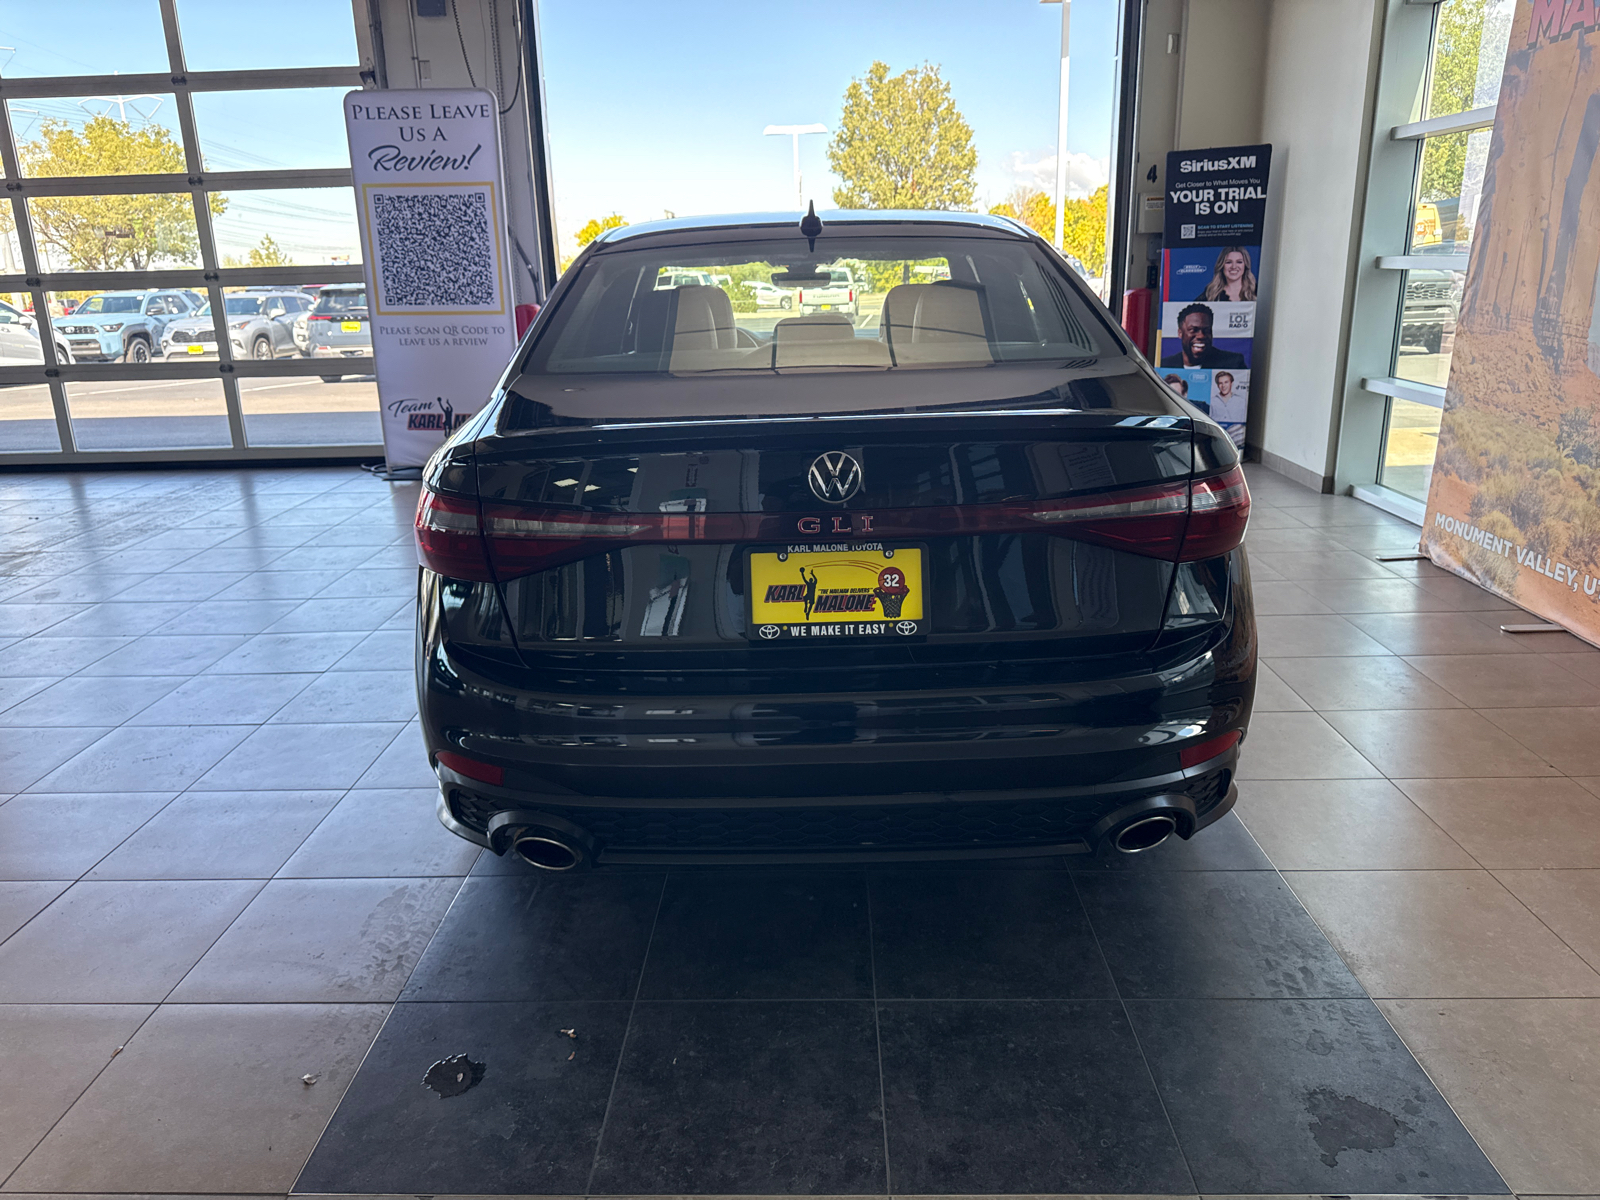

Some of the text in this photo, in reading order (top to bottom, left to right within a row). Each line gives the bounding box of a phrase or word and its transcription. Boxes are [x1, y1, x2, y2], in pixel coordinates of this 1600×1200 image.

[1527, 0, 1600, 49] MA
[351, 103, 490, 120] PLEASE LEAVE
[399, 126, 448, 142] US A
[368, 143, 482, 171] Review!
[1180, 155, 1257, 173] SiriusXM
[1146, 164, 1158, 183] 4
[1170, 186, 1266, 203] YOUR TRIAL
[1195, 201, 1239, 215] IS ON
[1229, 315, 1248, 324] LOL
[380, 325, 505, 336] PLEASE SCAN QR CODE TO
[399, 338, 488, 346] LEAVE US A REVIEW
[388, 398, 436, 418] Team
[407, 413, 445, 431] KARL
[797, 515, 874, 534] GLI
[788, 545, 811, 553] KARL
[813, 543, 848, 552] MALONE
[1435, 512, 1513, 558] MONUMENT
[1516, 546, 1578, 592] VALLEY,
[883, 574, 900, 587] 32
[764, 584, 876, 613] KARL MALONE
[790, 624, 886, 637] WE MAKE IT EASY
